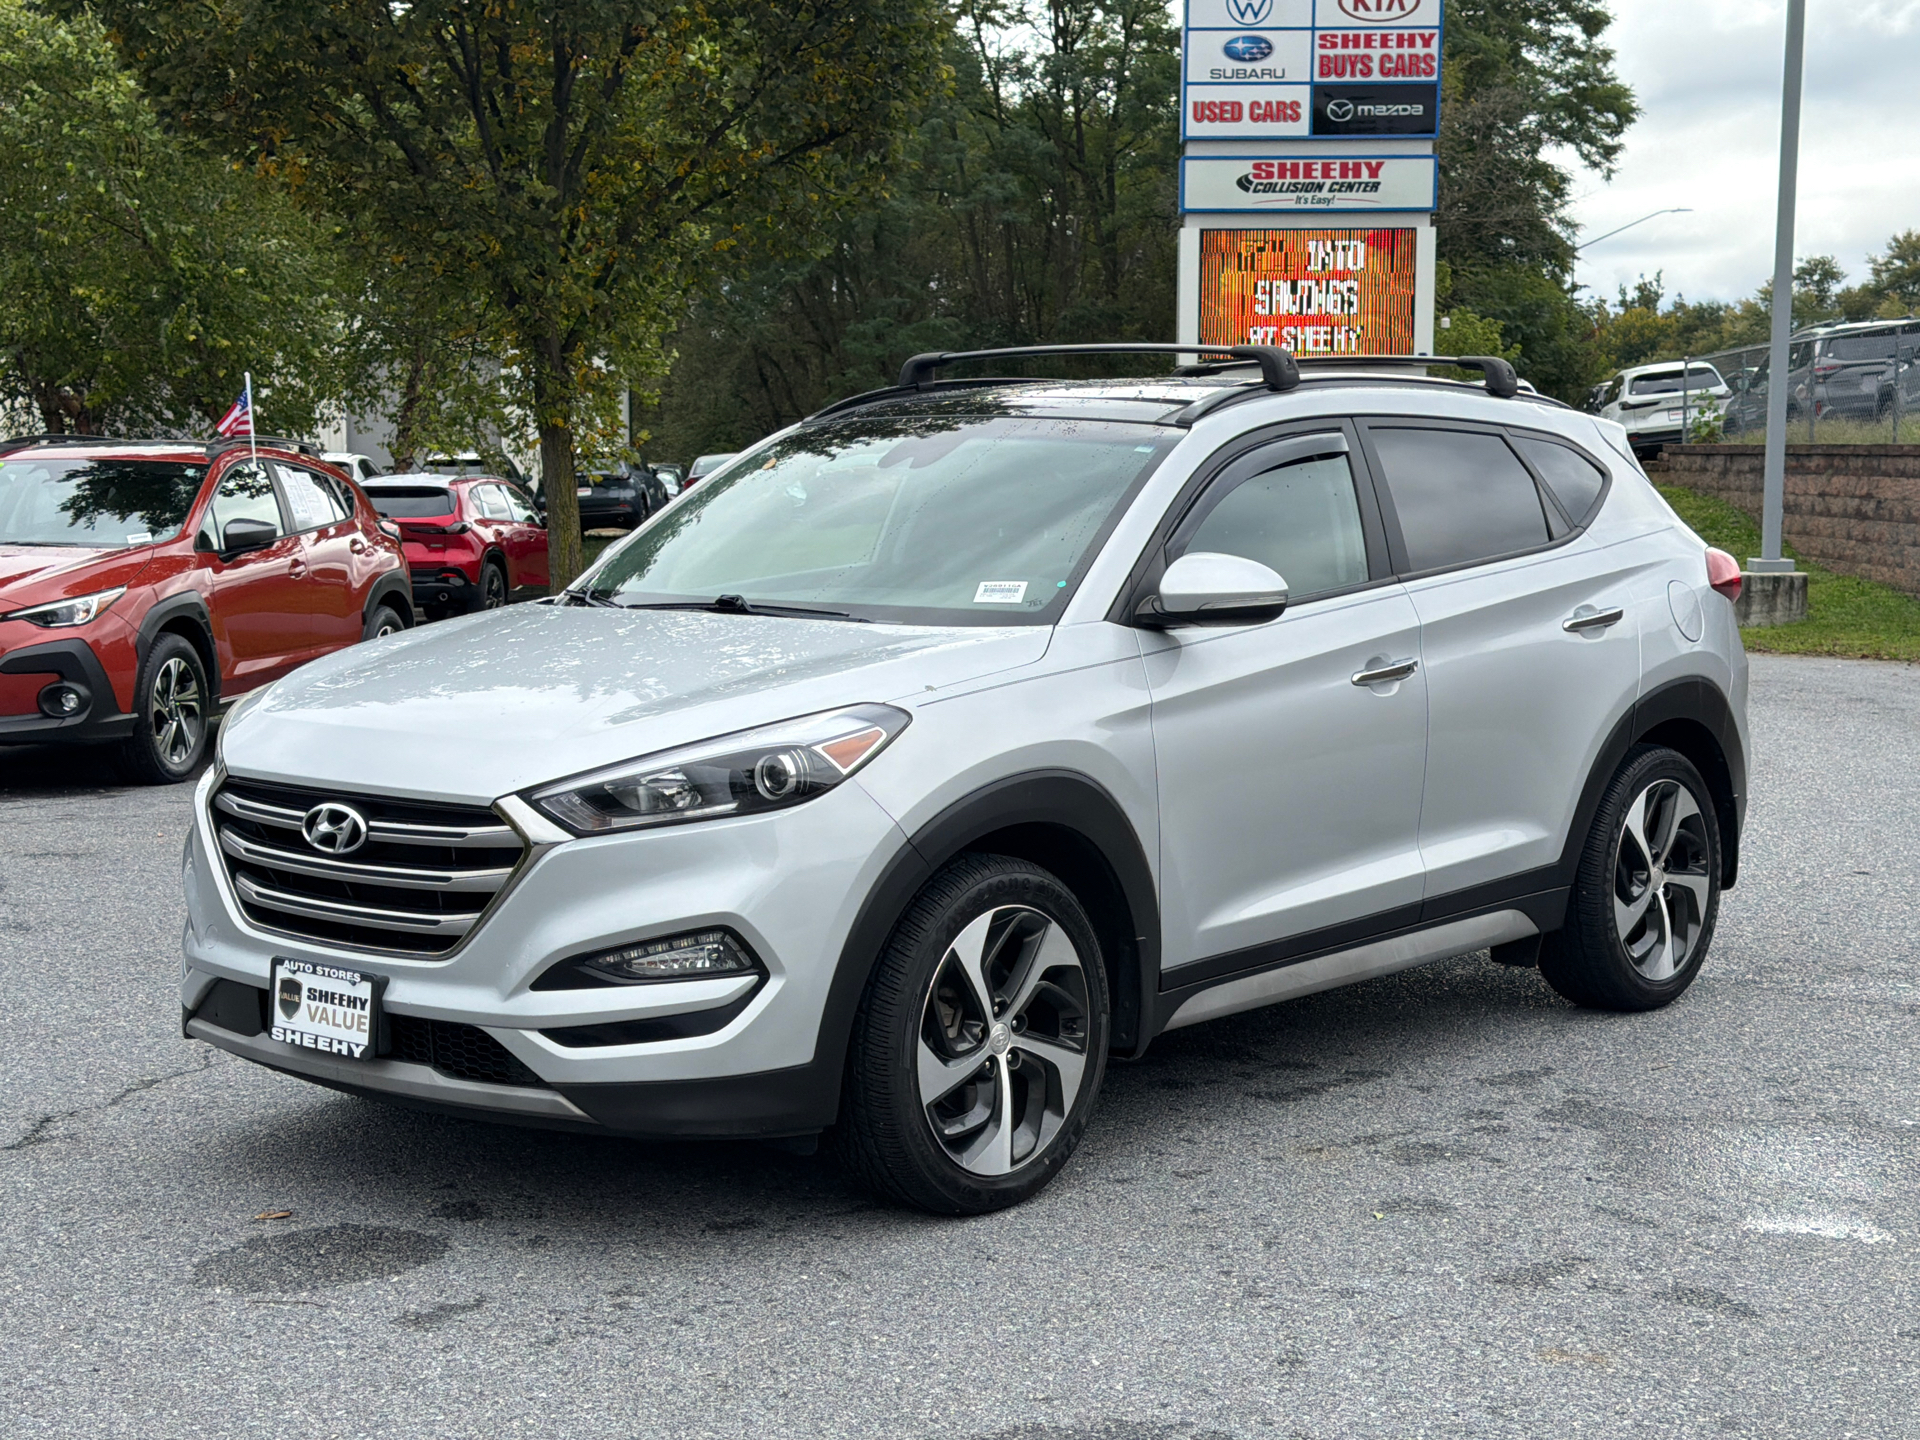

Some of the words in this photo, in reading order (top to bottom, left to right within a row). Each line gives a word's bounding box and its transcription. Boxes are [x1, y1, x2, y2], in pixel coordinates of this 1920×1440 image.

[1318, 33, 1436, 49] SHEEHY
[1209, 68, 1285, 79] SUBARU
[1318, 54, 1373, 78] BUYS
[1379, 53, 1435, 77] CARS
[1192, 101, 1243, 123] USED
[1250, 101, 1302, 122] CARS
[1252, 161, 1385, 180] SHEEHY
[1252, 181, 1325, 193] COLLISION
[1327, 181, 1381, 193] CENTER
[1295, 195, 1309, 205] It's
[1310, 194, 1336, 206] Easy!
[282, 960, 313, 973] AUTO
[316, 966, 361, 983] STORES
[306, 987, 369, 1012] SHEEHY
[306, 1003, 368, 1034] VALUE
[271, 1027, 366, 1059] SHEEHY
